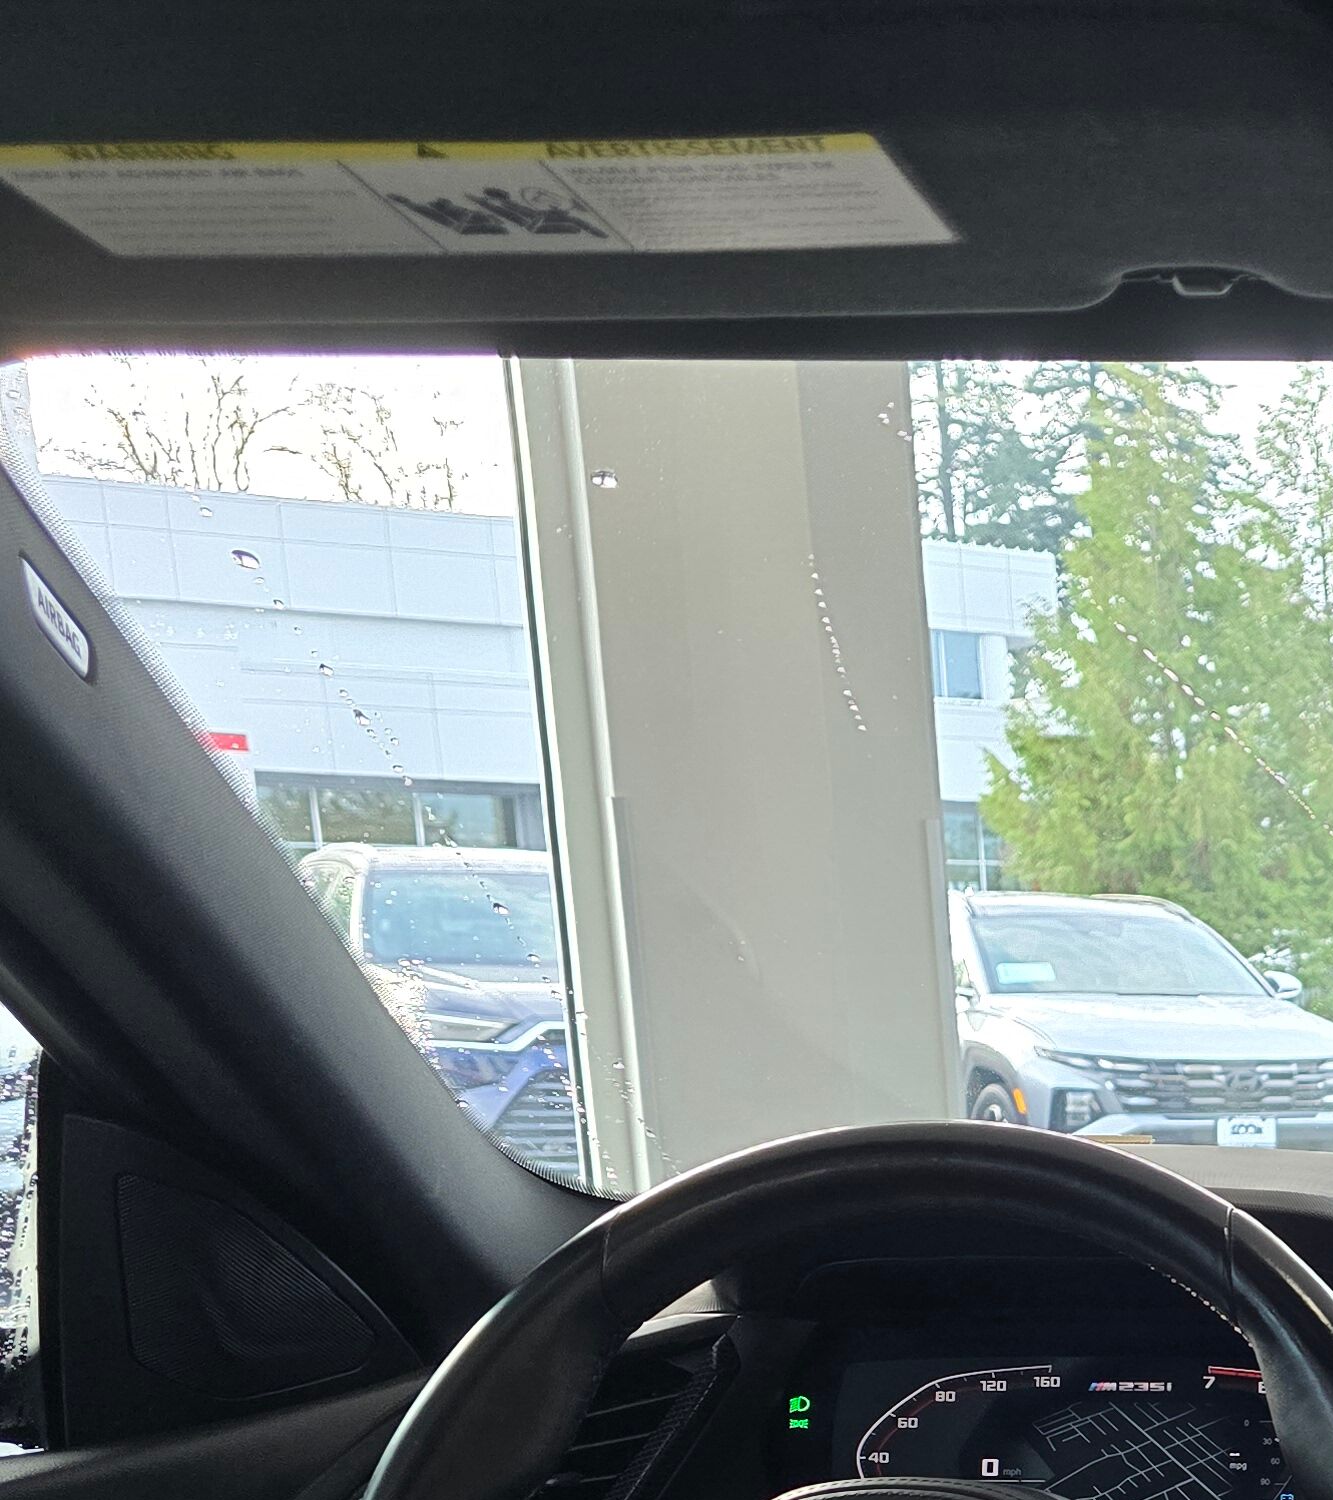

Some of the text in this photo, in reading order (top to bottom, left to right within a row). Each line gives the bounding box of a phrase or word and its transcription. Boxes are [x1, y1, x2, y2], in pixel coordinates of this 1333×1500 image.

[62, 142, 236, 161] WARNING
[546, 135, 828, 158] AVERTISSEMENT
[37, 587, 82, 660] AIRBAG
[979, 1380, 1008, 1392] 120
[1033, 1376, 1061, 1389] 160
[1202, 1375, 1216, 1389] 7
[935, 1391, 957, 1403] 80
[897, 1417, 919, 1430] 60
[867, 1451, 890, 1464] 40
[981, 1458, 1022, 1479] 0 mph
[1229, 1462, 1248, 1472] mpg
